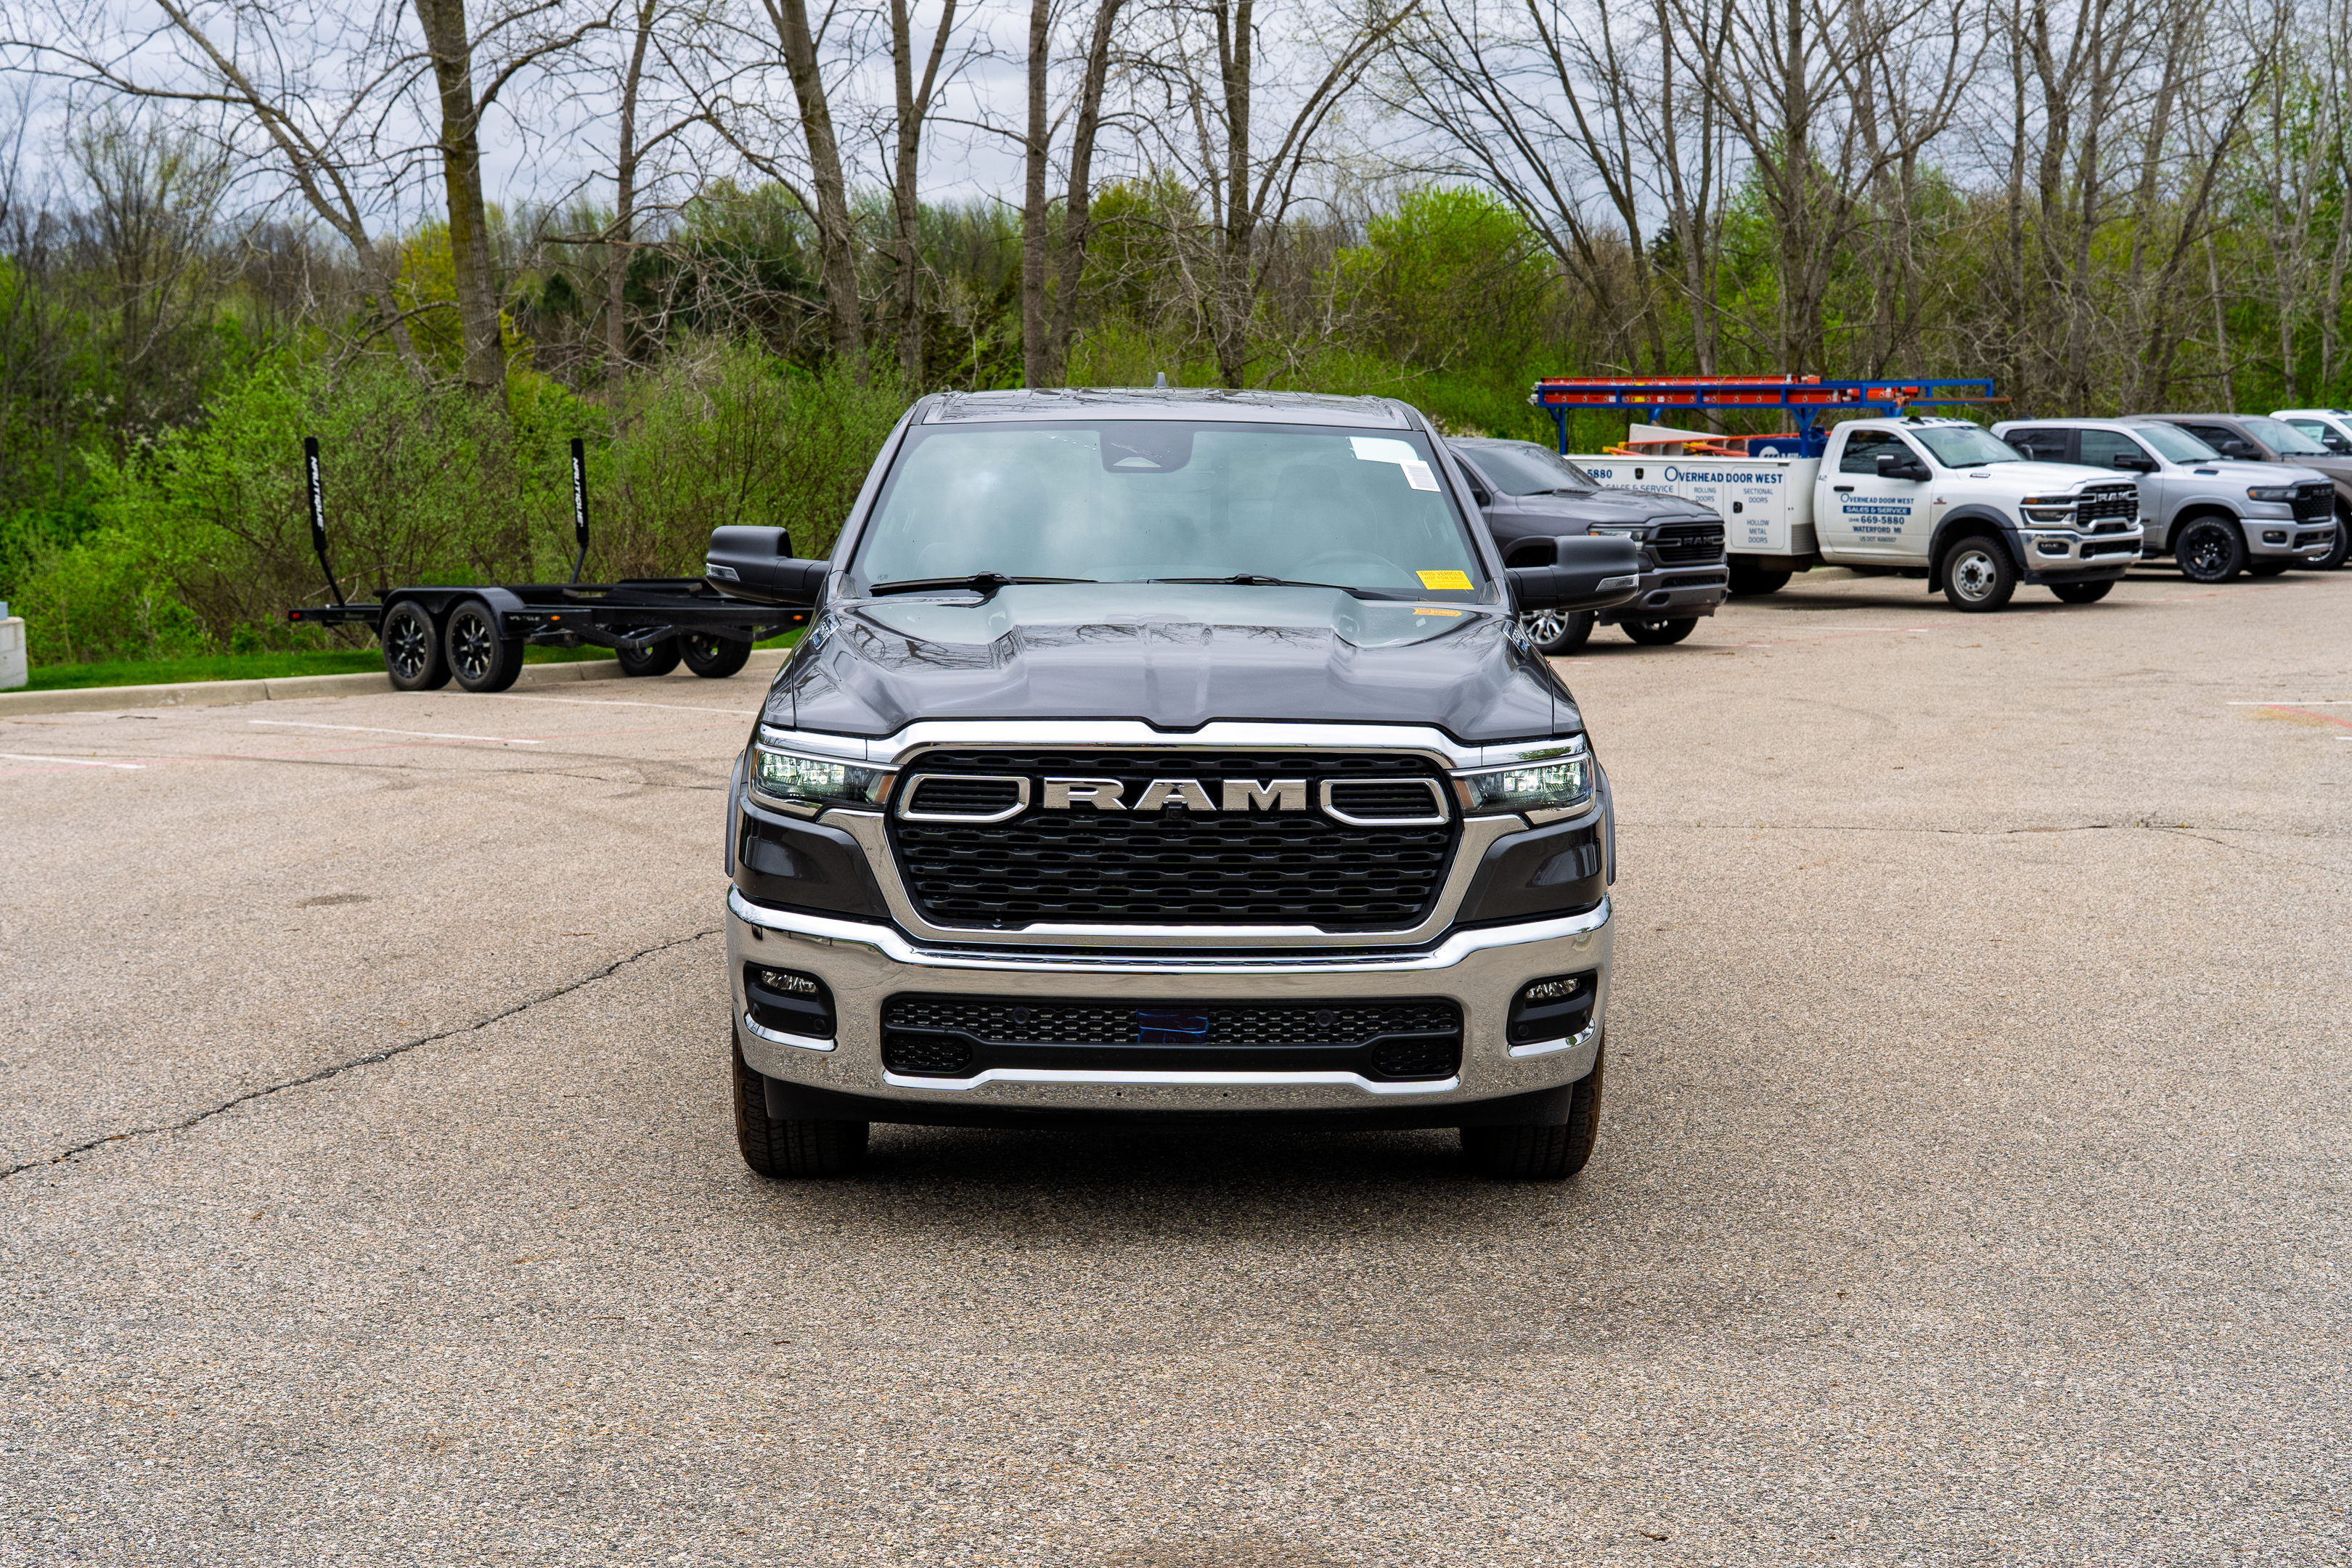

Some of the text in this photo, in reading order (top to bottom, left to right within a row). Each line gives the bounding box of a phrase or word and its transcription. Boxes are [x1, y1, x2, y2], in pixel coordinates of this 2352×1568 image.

[1665, 466, 1783, 483] OVERHEAD DOOR WEST
[311, 455, 324, 528] NAUTIQUE
[573, 457, 584, 525] NAUTIQUE
[1640, 484, 1673, 493] SERVICE
[1840, 493, 1878, 503] OVERHEAD
[2097, 491, 2130, 502] RAM
[1861, 515, 1905, 525] 669-5880
[1044, 776, 1307, 811] RAM
